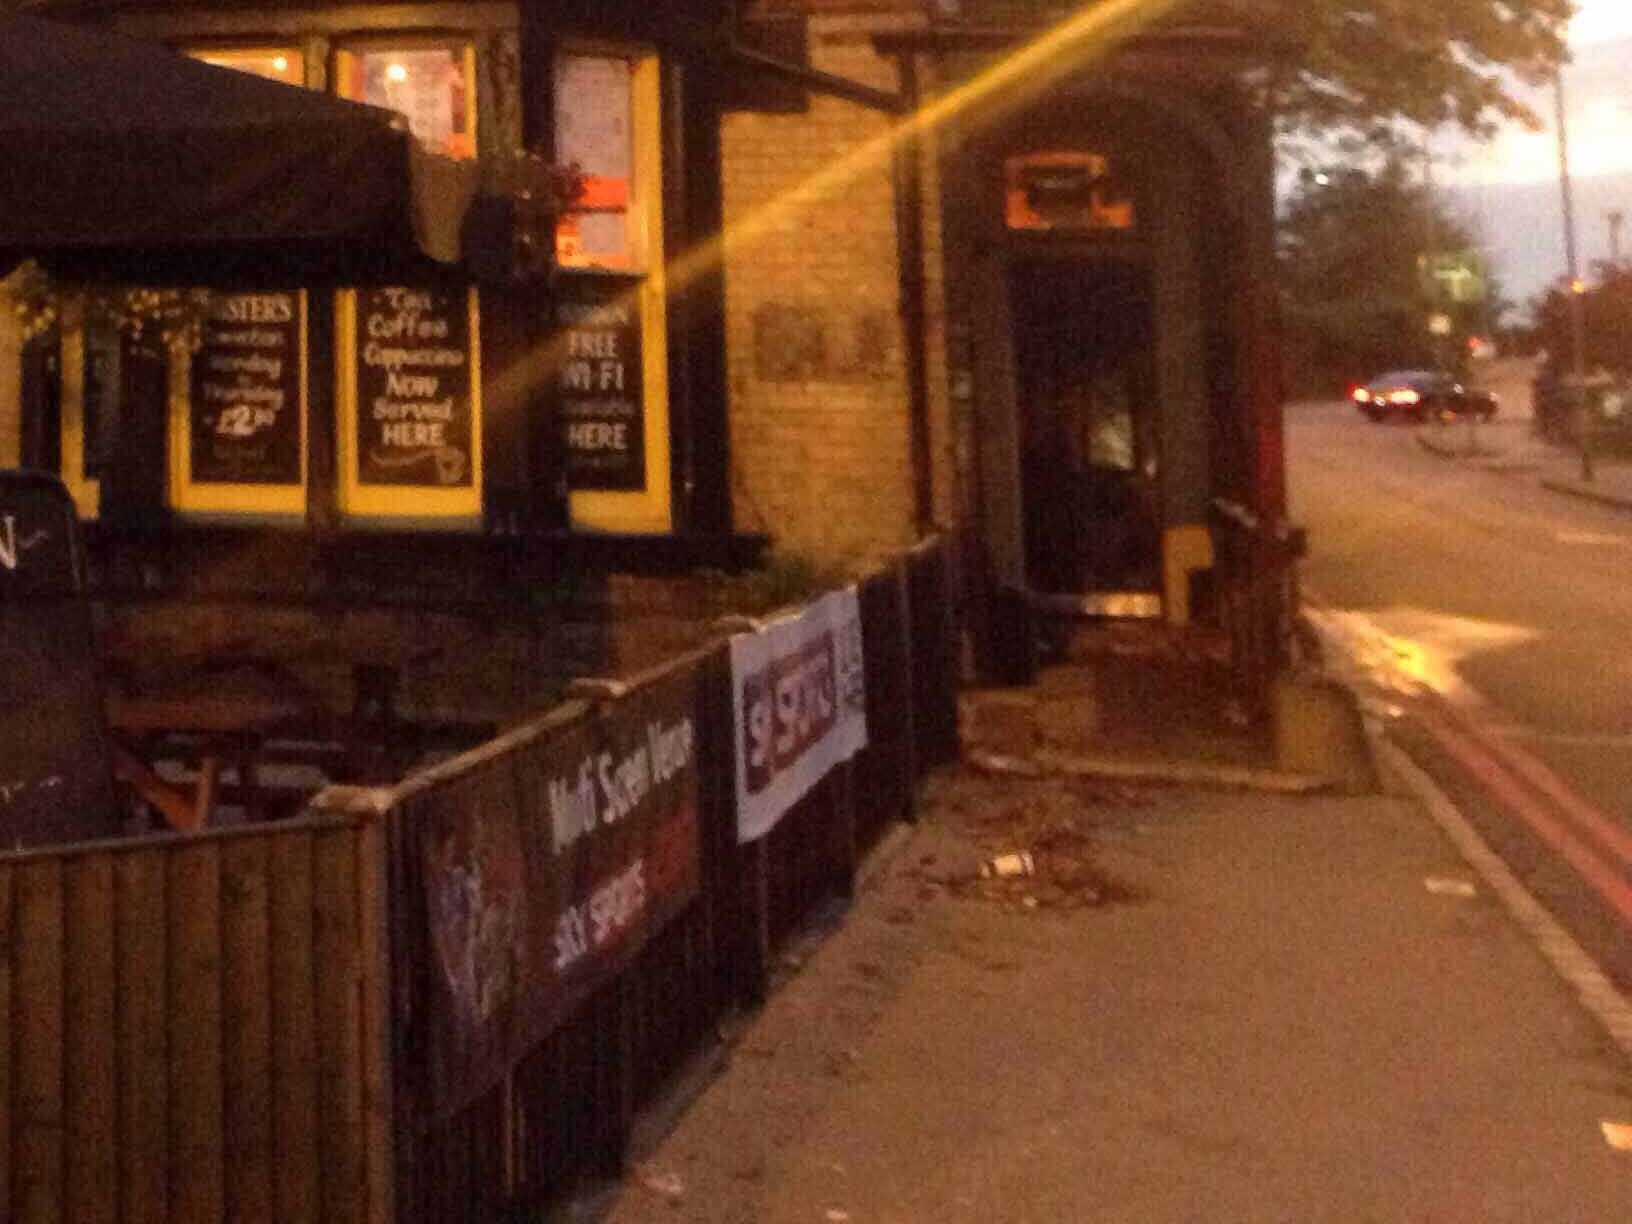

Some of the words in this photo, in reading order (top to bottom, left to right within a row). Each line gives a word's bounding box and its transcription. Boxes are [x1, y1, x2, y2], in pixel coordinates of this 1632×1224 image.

[568, 330, 618, 358] FREE
[382, 422, 446, 448] HERE
[568, 422, 628, 452] HERE
